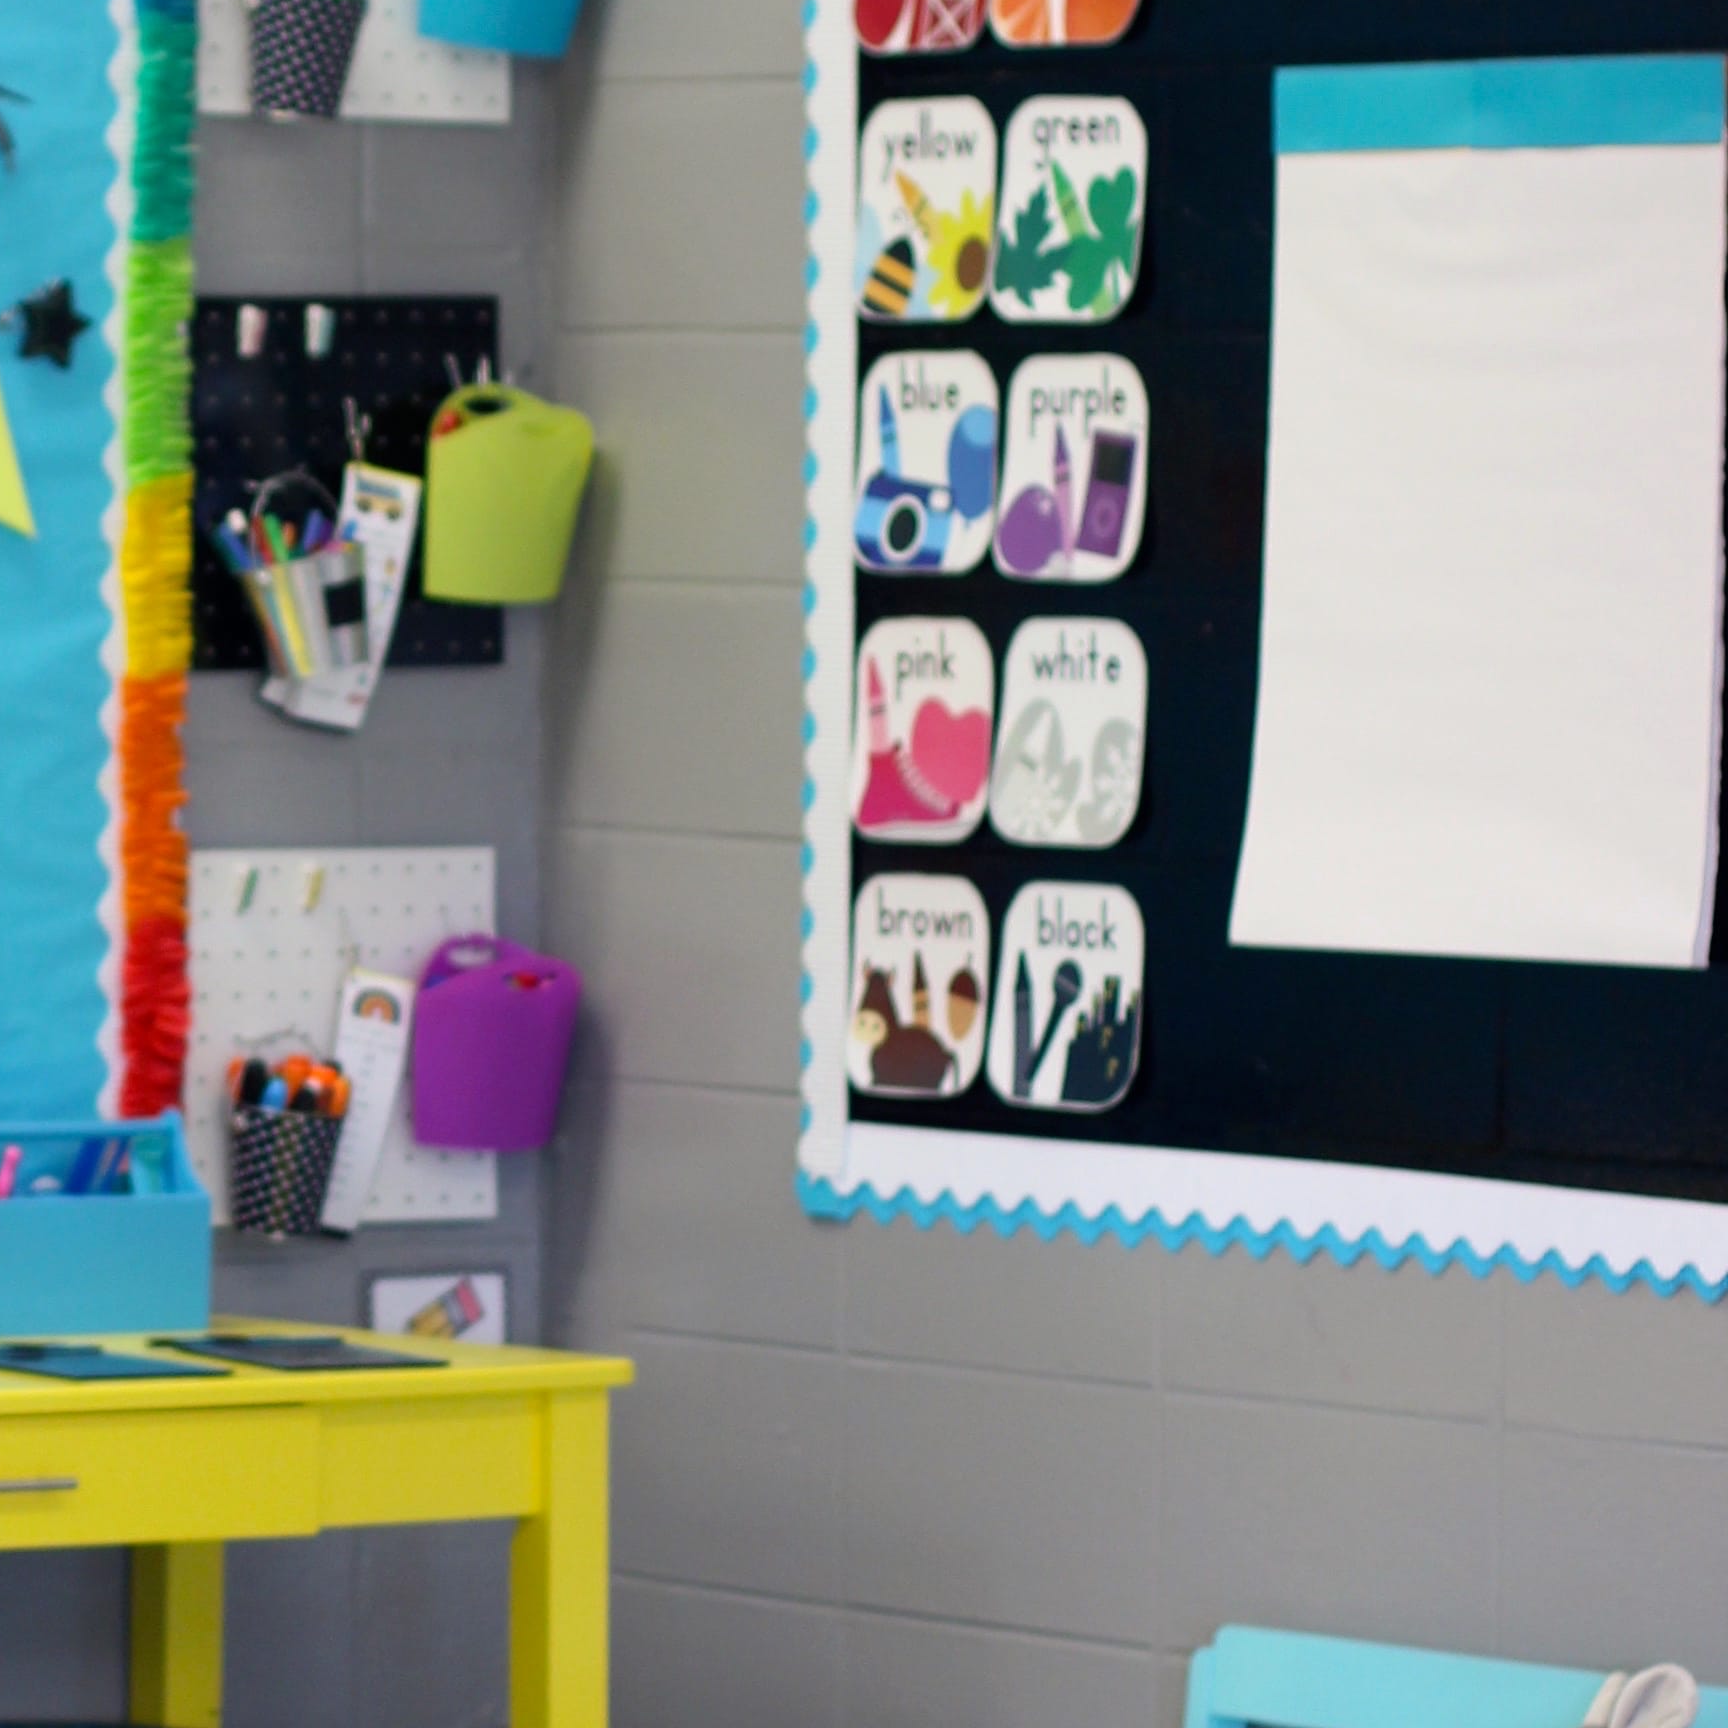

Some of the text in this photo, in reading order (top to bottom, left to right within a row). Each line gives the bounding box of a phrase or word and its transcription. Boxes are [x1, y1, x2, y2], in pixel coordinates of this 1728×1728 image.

[883, 110, 976, 181] yellow
[1032, 111, 1121, 168] green
[900, 361, 960, 410] blue
[1030, 365, 1127, 438] purple
[895, 632, 956, 700] pink
[1033, 633, 1121, 684] white
[877, 888, 973, 939] brown
[1037, 895, 1118, 951] black
